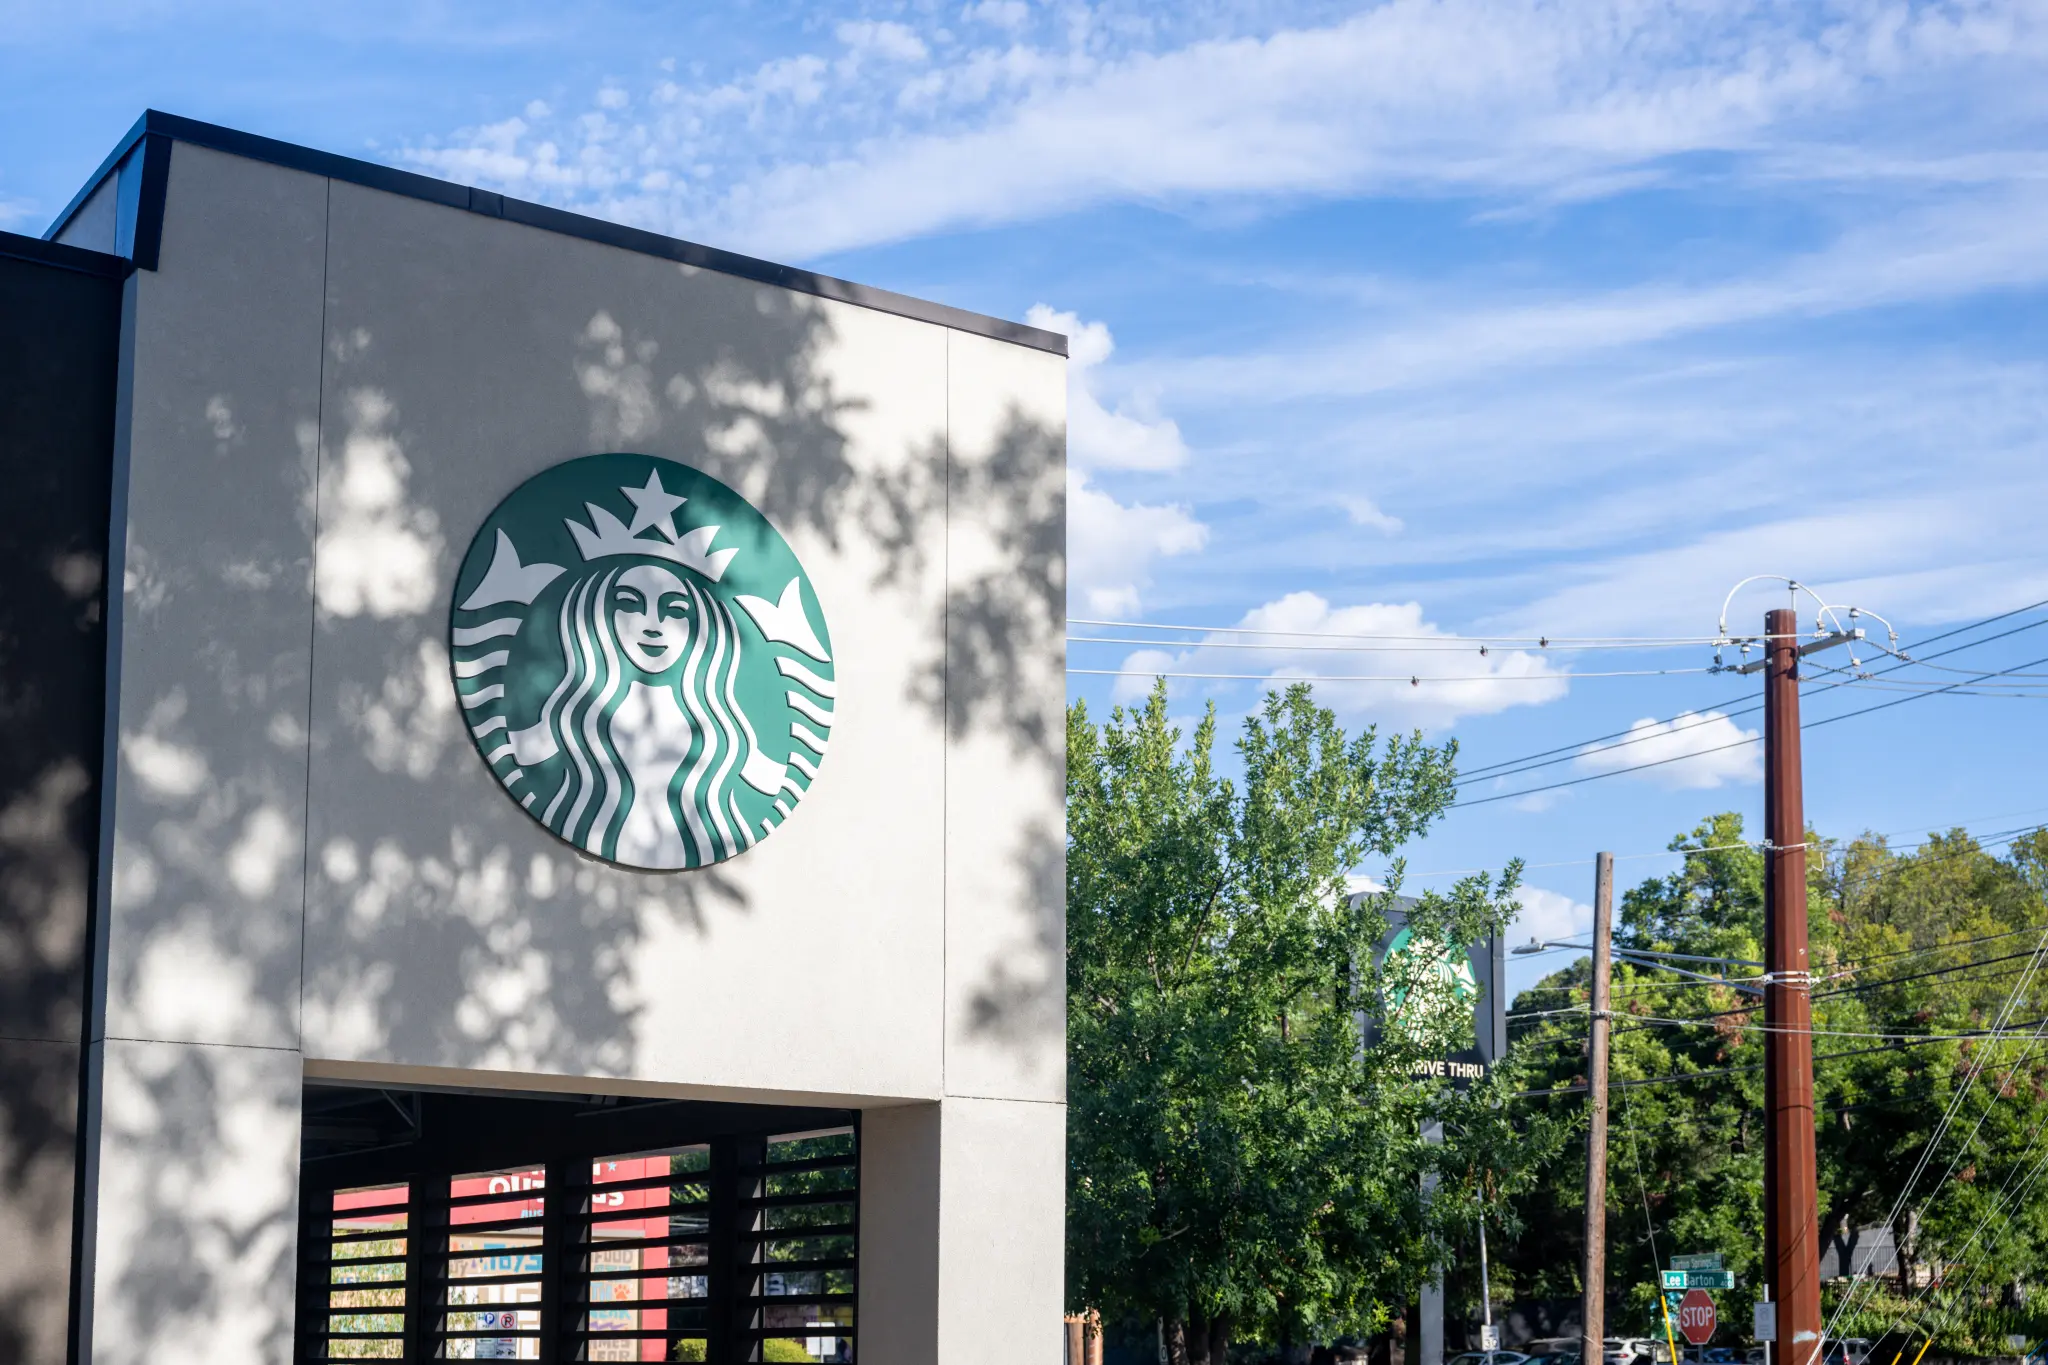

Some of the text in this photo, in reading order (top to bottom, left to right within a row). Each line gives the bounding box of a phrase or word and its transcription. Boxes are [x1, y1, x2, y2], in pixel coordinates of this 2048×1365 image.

[1448, 1061, 1484, 1078] THRU
[1665, 1273, 1715, 1287] Lee Barton
[1682, 1307, 1713, 1327] STOP
